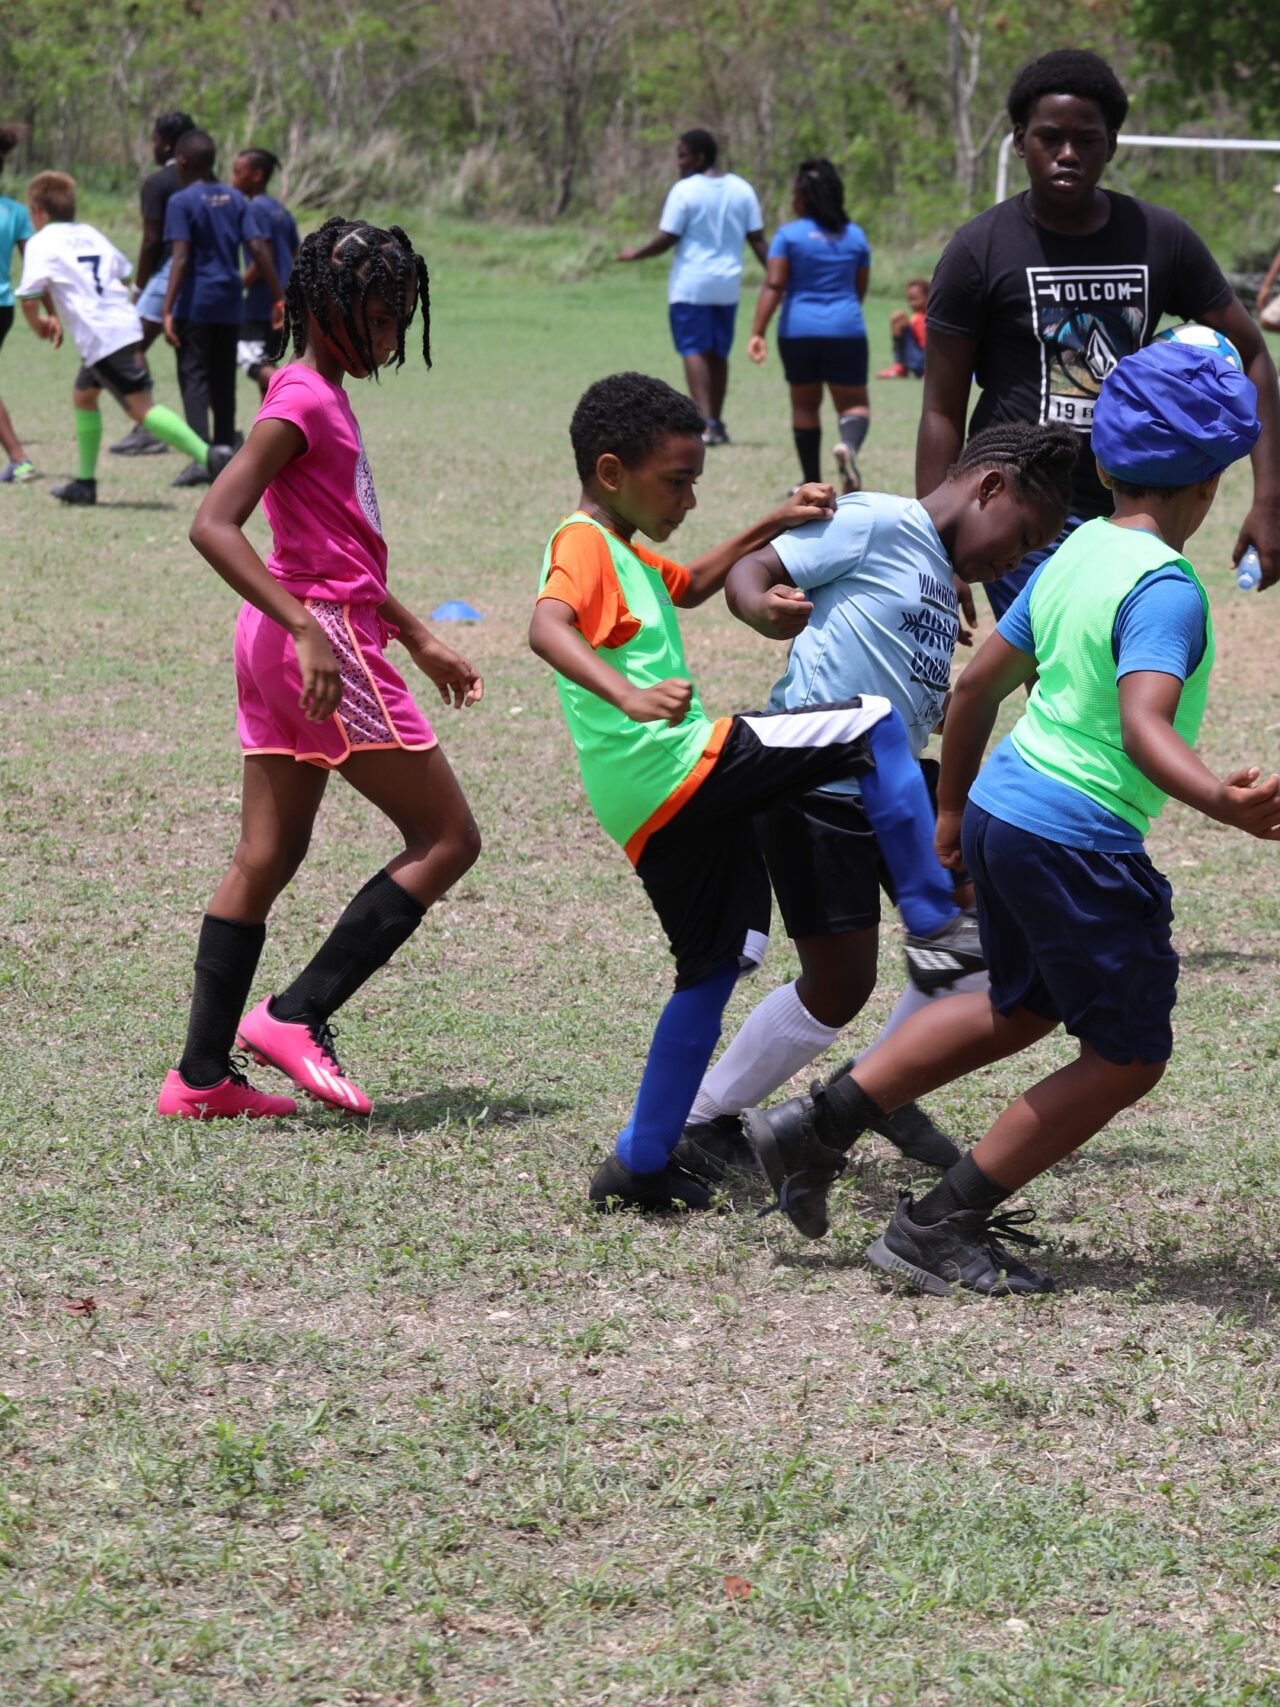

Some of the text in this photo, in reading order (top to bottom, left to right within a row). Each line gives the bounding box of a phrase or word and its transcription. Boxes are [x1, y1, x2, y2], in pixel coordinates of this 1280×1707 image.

[77, 255, 103, 296] 7
[1050, 282, 1131, 301] VOLCOM
[1056, 401, 1075, 419] 19
